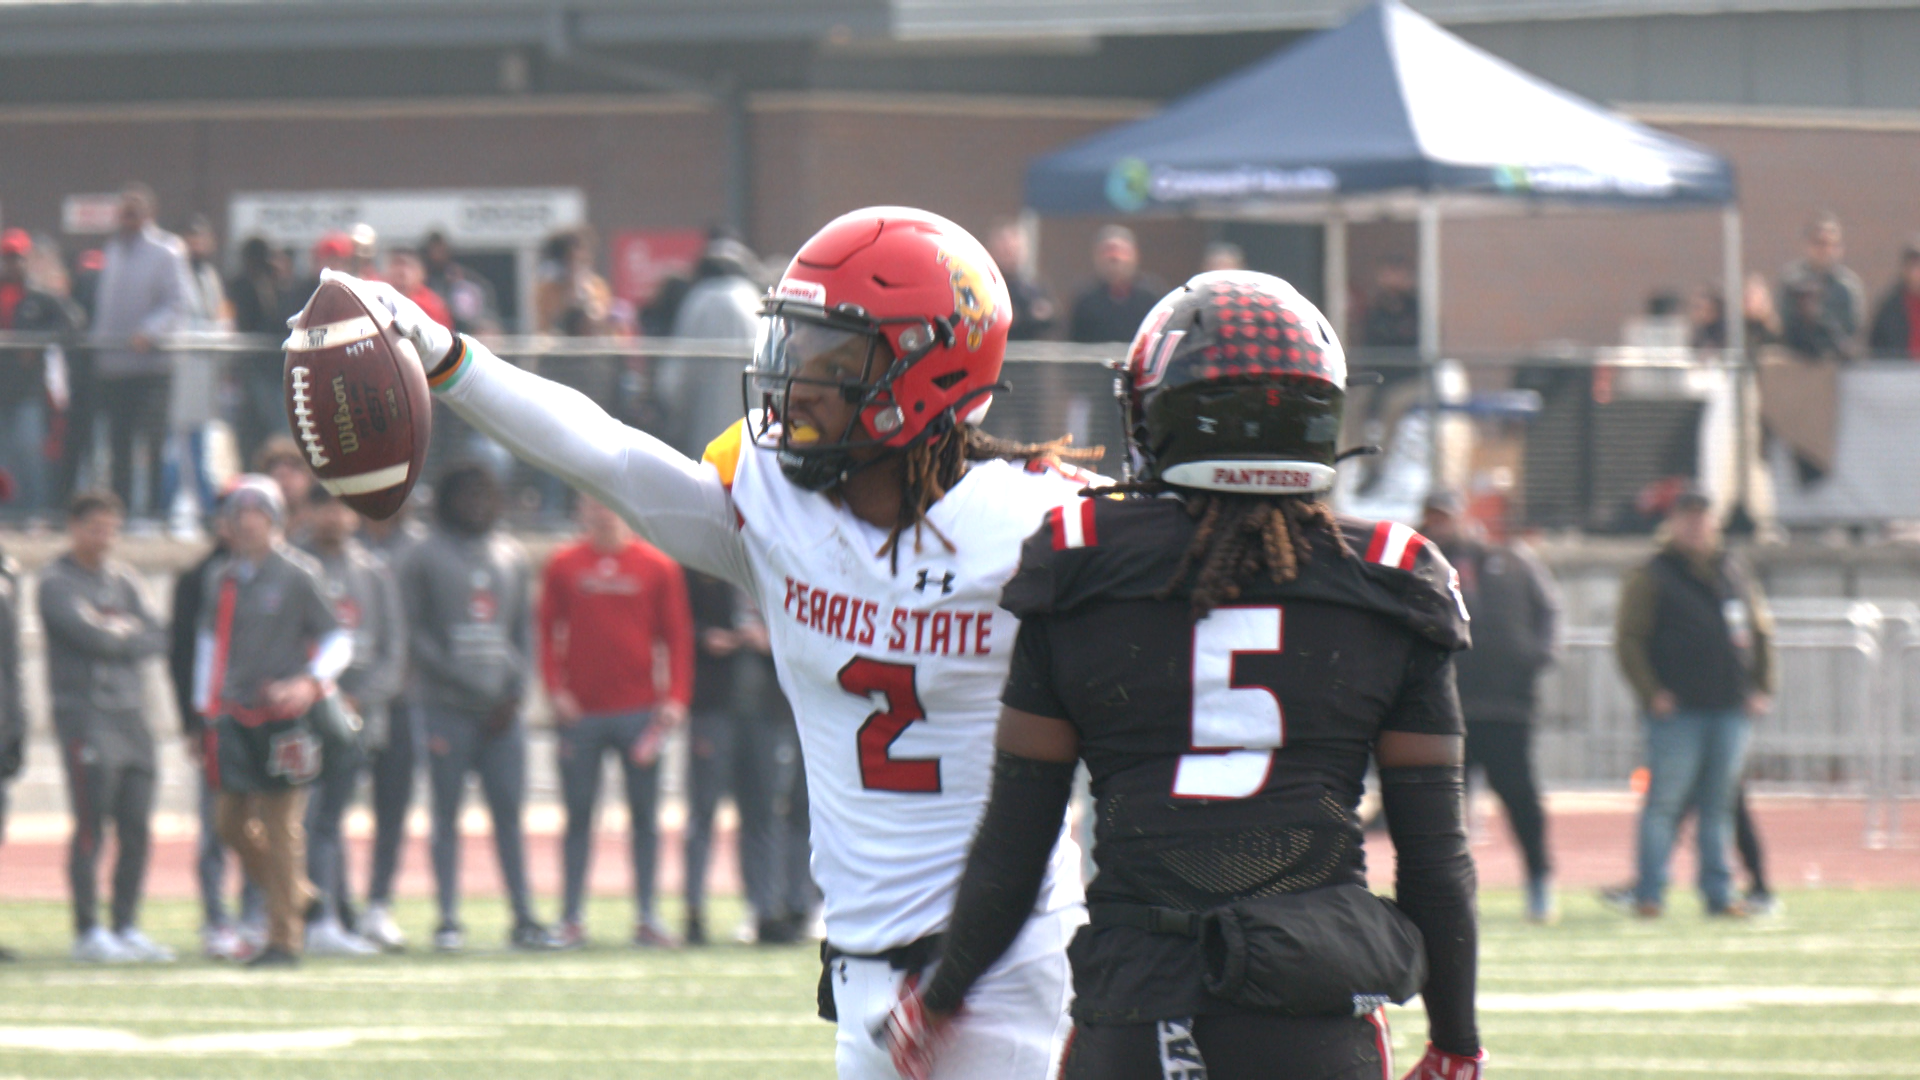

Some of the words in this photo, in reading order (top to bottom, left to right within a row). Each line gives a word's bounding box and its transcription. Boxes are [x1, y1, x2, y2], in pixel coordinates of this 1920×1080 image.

[332, 374, 359, 455] Wilson
[1266, 387, 1281, 408] 5
[1212, 467, 1312, 488] PANTHERS
[784, 574, 879, 648] FERRIS
[887, 606, 993, 657] STATE
[837, 654, 942, 793] 2
[1170, 604, 1287, 801] 5
